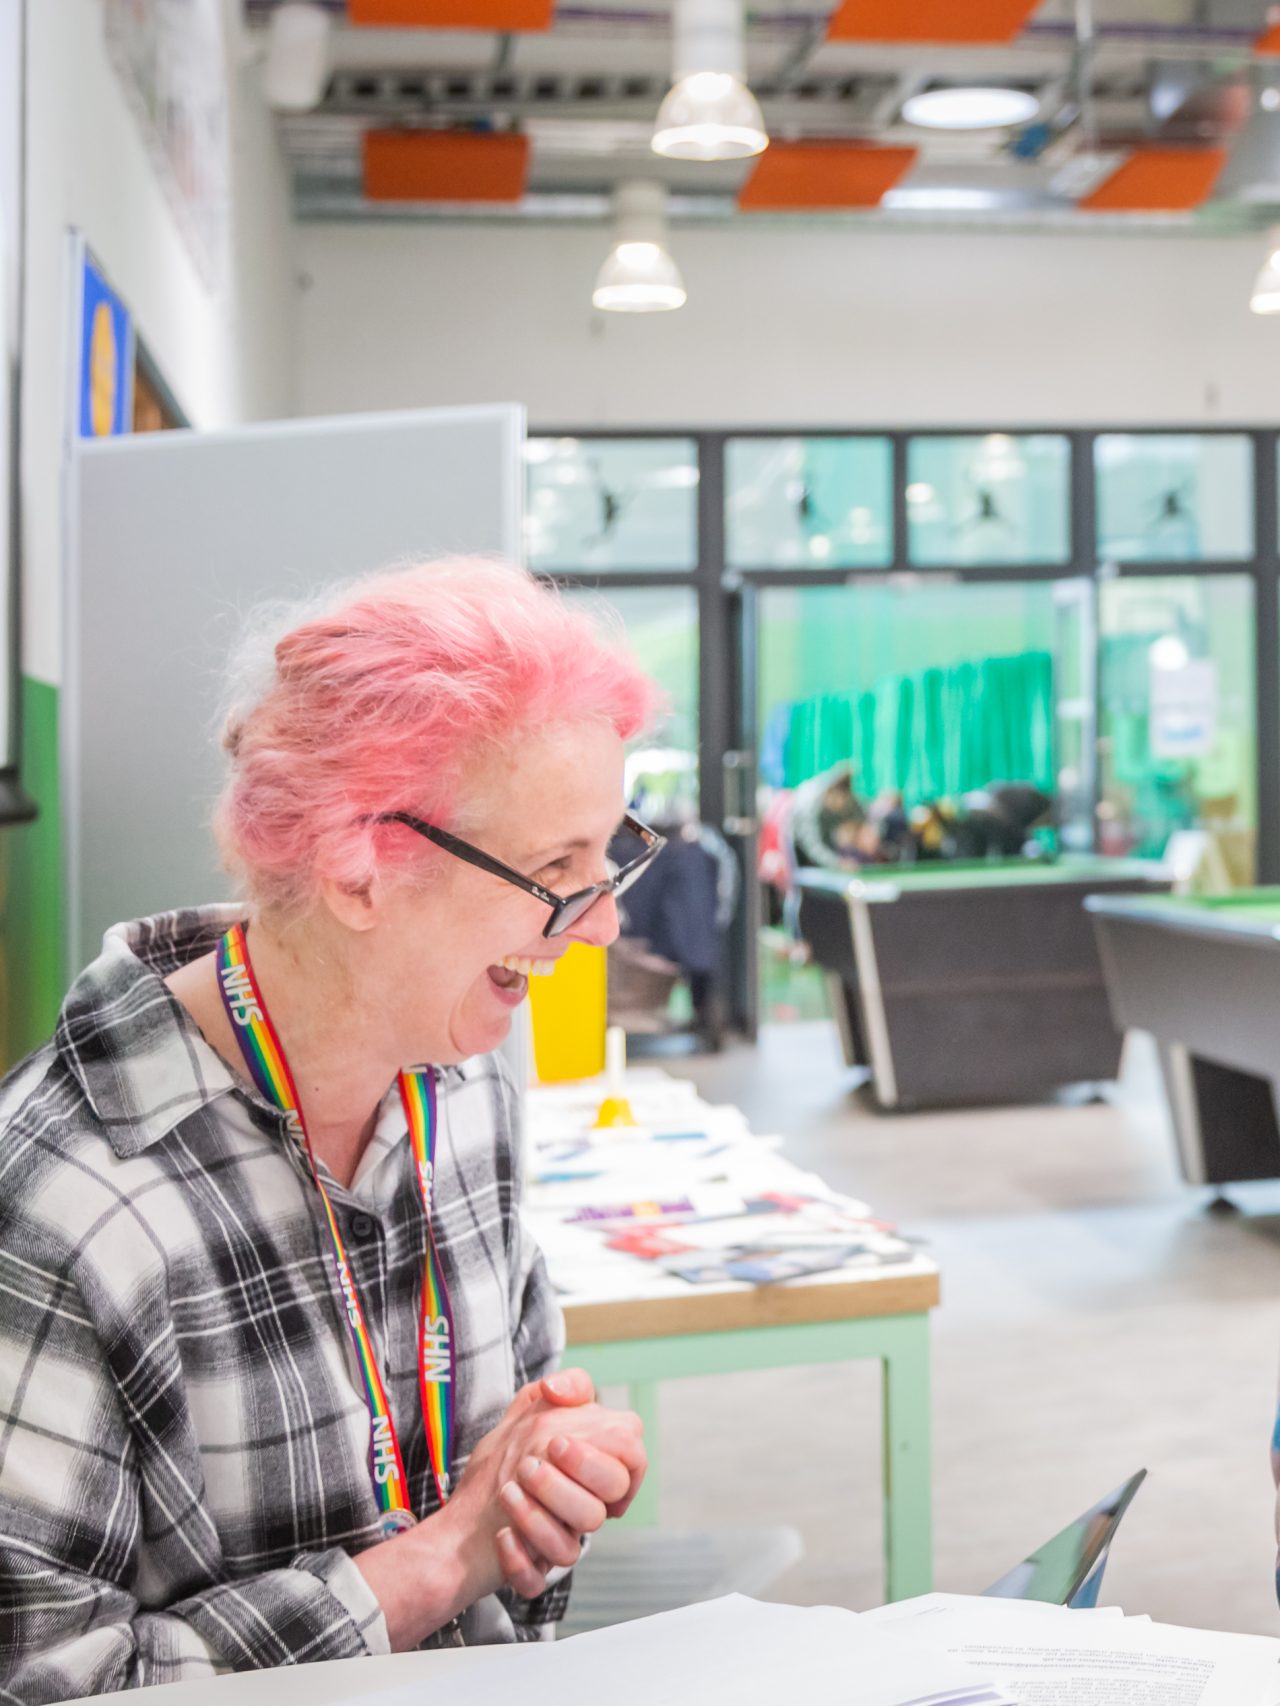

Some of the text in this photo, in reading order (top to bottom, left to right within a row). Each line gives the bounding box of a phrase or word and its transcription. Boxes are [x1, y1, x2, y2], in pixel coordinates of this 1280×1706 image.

[220, 963, 263, 1026] NHS
[336, 1262, 361, 1328] NHS
[424, 1315, 451, 1383] NHS
[372, 1414, 400, 1485] NHS
